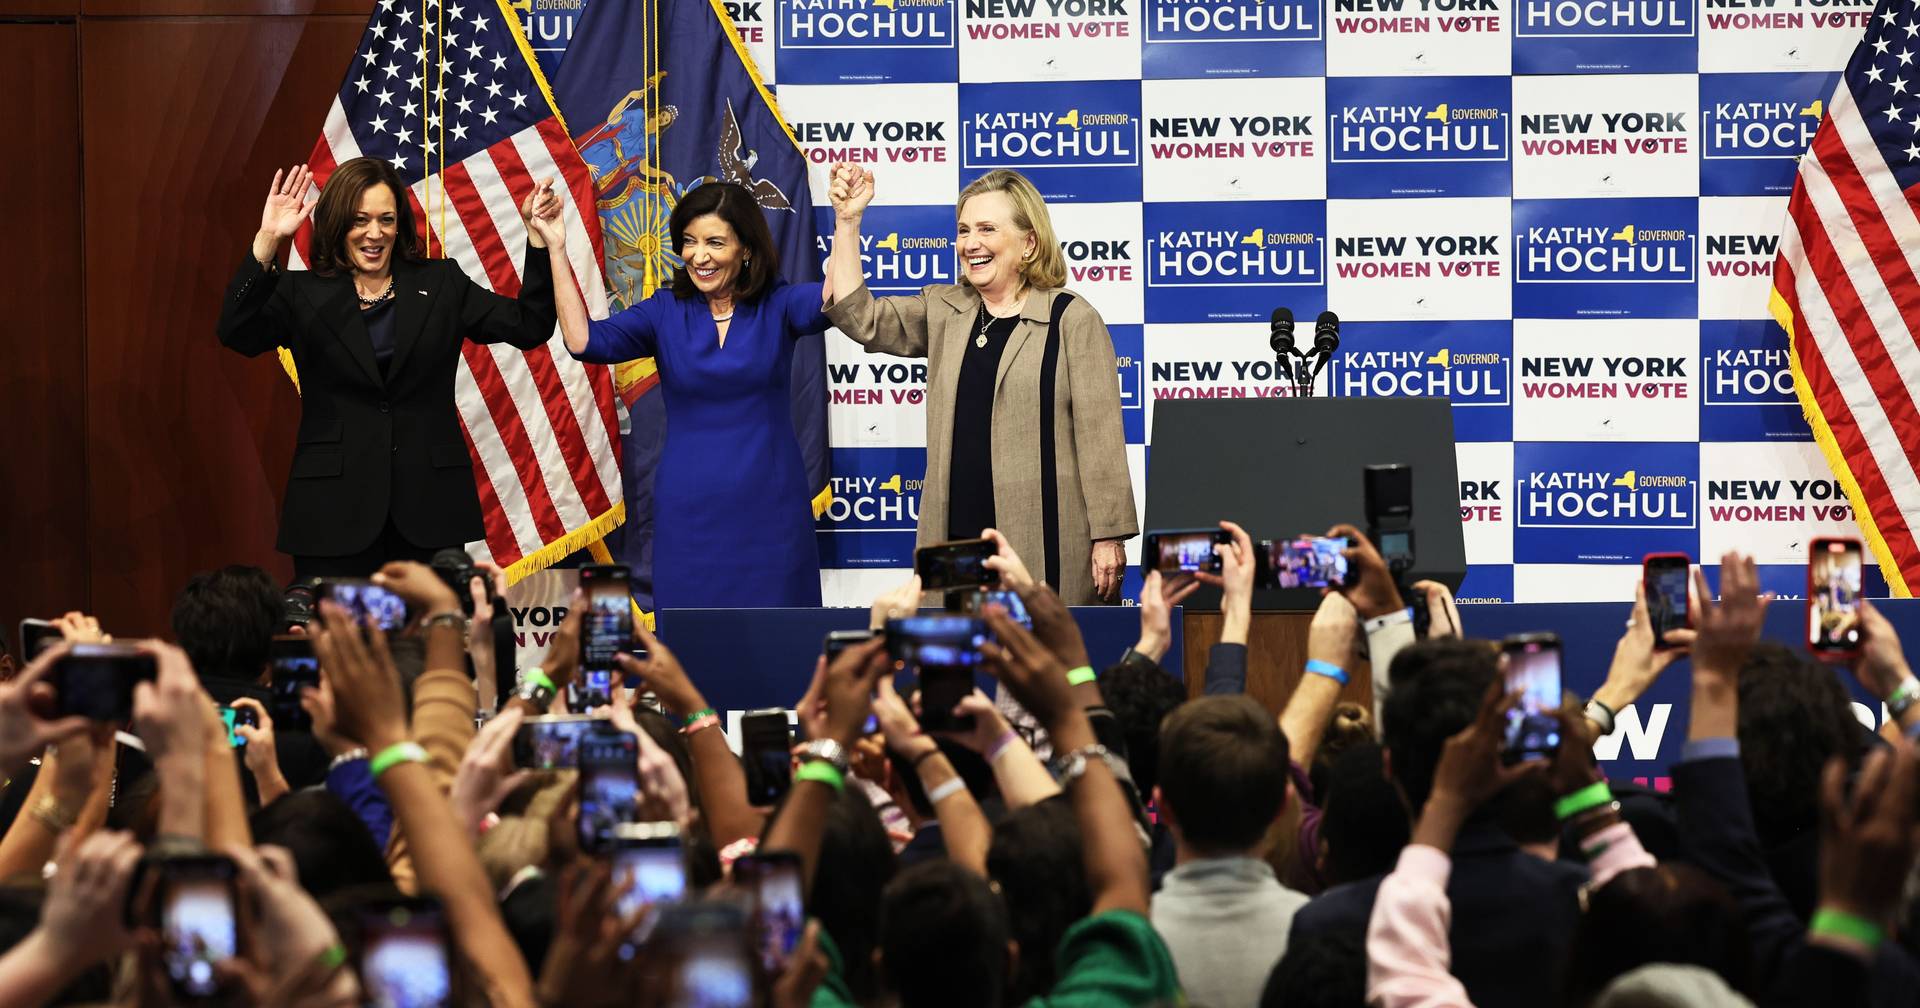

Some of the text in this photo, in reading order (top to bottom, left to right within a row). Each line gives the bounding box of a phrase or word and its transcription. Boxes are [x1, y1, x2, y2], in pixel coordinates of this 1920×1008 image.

[536, 0, 581, 10] GOVERNOR
[723, 2, 763, 22] RK
[966, 0, 1128, 18] NEW YORK
[1528, 1, 1686, 27] HOCHUL
[791, 12, 945, 38] HOCHUL
[1157, 6, 1312, 32] HOCHUL
[1336, 17, 1500, 33] WOMEN VOTE
[1707, 14, 1803, 30] WOMEN
[736, 27, 763, 43] TE
[968, 22, 1129, 39] WOMEN VOTE
[1343, 107, 1498, 123] KATHY GOVERNOR
[1716, 103, 1797, 119] KATHY
[975, 112, 1129, 130] KATHY GOVERNOR
[1150, 116, 1312, 137] NEW YORK
[1521, 112, 1686, 134] NEW YORK
[863, 121, 946, 142] YORK
[1343, 125, 1499, 151] HOCHUL
[1715, 122, 1820, 148] HOCH
[975, 131, 1129, 158] HOCHUL
[1151, 141, 1314, 159] WOMEN VOTE
[1522, 138, 1687, 155] WOMEN VOTE
[803, 147, 946, 164] OMEN VOTE
[902, 237, 947, 248] GOVERNOR
[1160, 232, 1313, 248] KATHY GOVERNOR
[1529, 227, 1684, 244] KATHY GOVERNOR
[1061, 241, 1130, 260] ORK
[1336, 236, 1498, 256] NEW YORK
[1706, 235, 1779, 255] NEW
[1160, 249, 1314, 275] HOCHUL
[1529, 247, 1685, 273] HOCHUL
[1707, 261, 1775, 276] WOM
[1071, 266, 1132, 282] VOTE
[1336, 261, 1500, 278] WOMEN VOTE
[1345, 352, 1499, 368] KATHY GOVERNOR
[1522, 357, 1687, 377] NEW YORK
[868, 364, 928, 384] YOR
[1152, 361, 1222, 381] NEW
[1345, 370, 1500, 396] HOCHUL
[1522, 382, 1687, 398] WOMEN VOTE
[1717, 369, 1795, 394] HOC
[827, 389, 927, 404] MEN VO
[1153, 386, 1246, 399] WOMEN
[830, 477, 876, 493] THY
[1530, 473, 1687, 489] KATHY GOVERNOR
[1708, 480, 1849, 500] NEW YOR
[1461, 481, 1500, 500] RK
[826, 496, 919, 521] OCHU
[1460, 506, 1501, 521] OTE
[1530, 492, 1686, 518] HOCHUL
[1709, 506, 1804, 521] WOMEN
[510, 607, 569, 626] YOR
